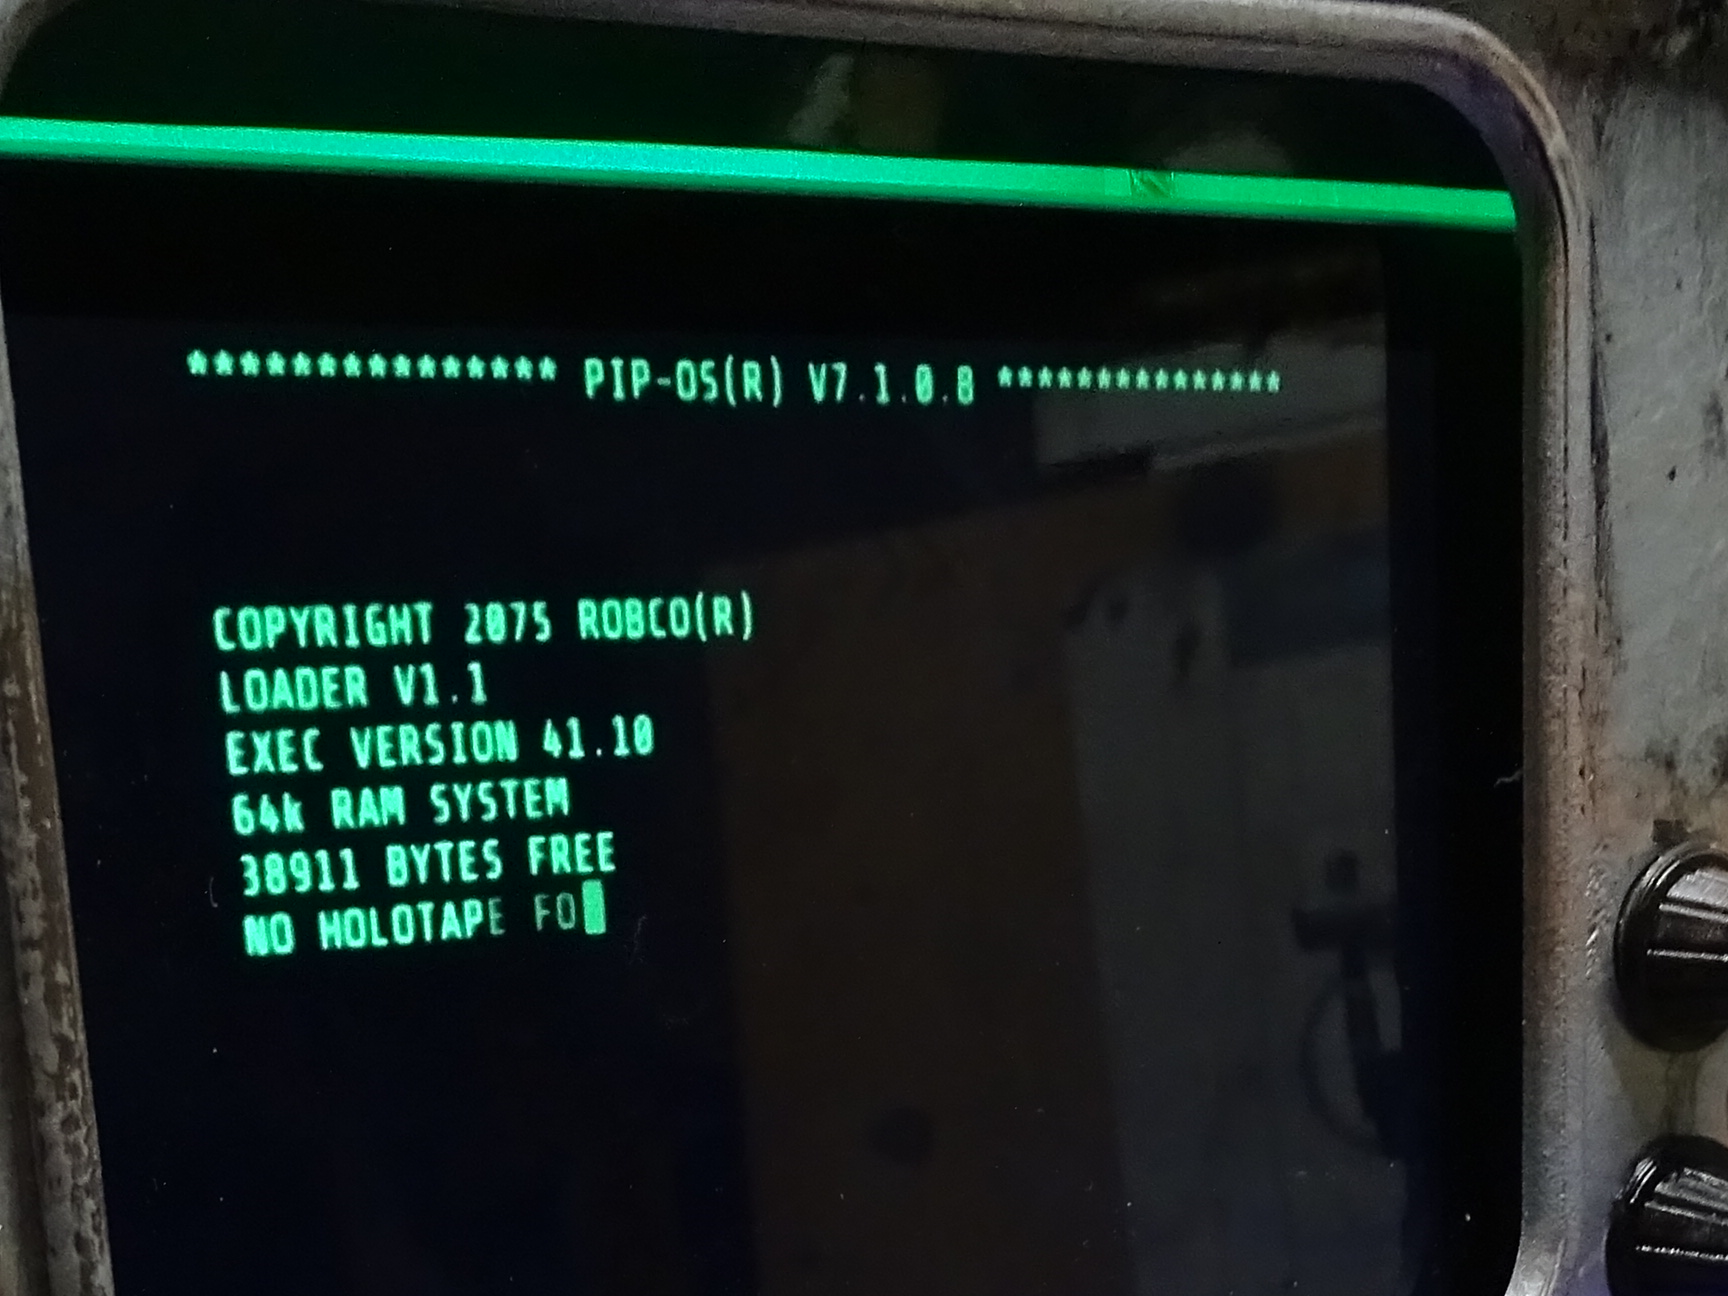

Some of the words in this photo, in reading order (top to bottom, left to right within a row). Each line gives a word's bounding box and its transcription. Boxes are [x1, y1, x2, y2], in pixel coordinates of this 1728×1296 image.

[584, 354, 782, 408] PIP-OS(R)
[808, 362, 974, 406] V7.1.0.8
[212, 601, 433, 652] COPYRIGHT
[464, 601, 552, 645] 2075
[577, 590, 753, 642] ROBCO(R)
[219, 664, 369, 714] LOADER
[393, 661, 487, 707] V1.1
[225, 727, 324, 777] EXEC
[350, 719, 519, 770] VERSION
[542, 714, 654, 760] 41.10
[231, 792, 305, 836] 64k
[330, 785, 406, 829] RAM
[429, 776, 570, 826] SYSTEM
[240, 848, 360, 897] 38911
[385, 838, 503, 888] BYTES
[527, 831, 616, 877] FREE
[242, 911, 296, 957] NO
[317, 897, 506, 951] HOLOTAPE
